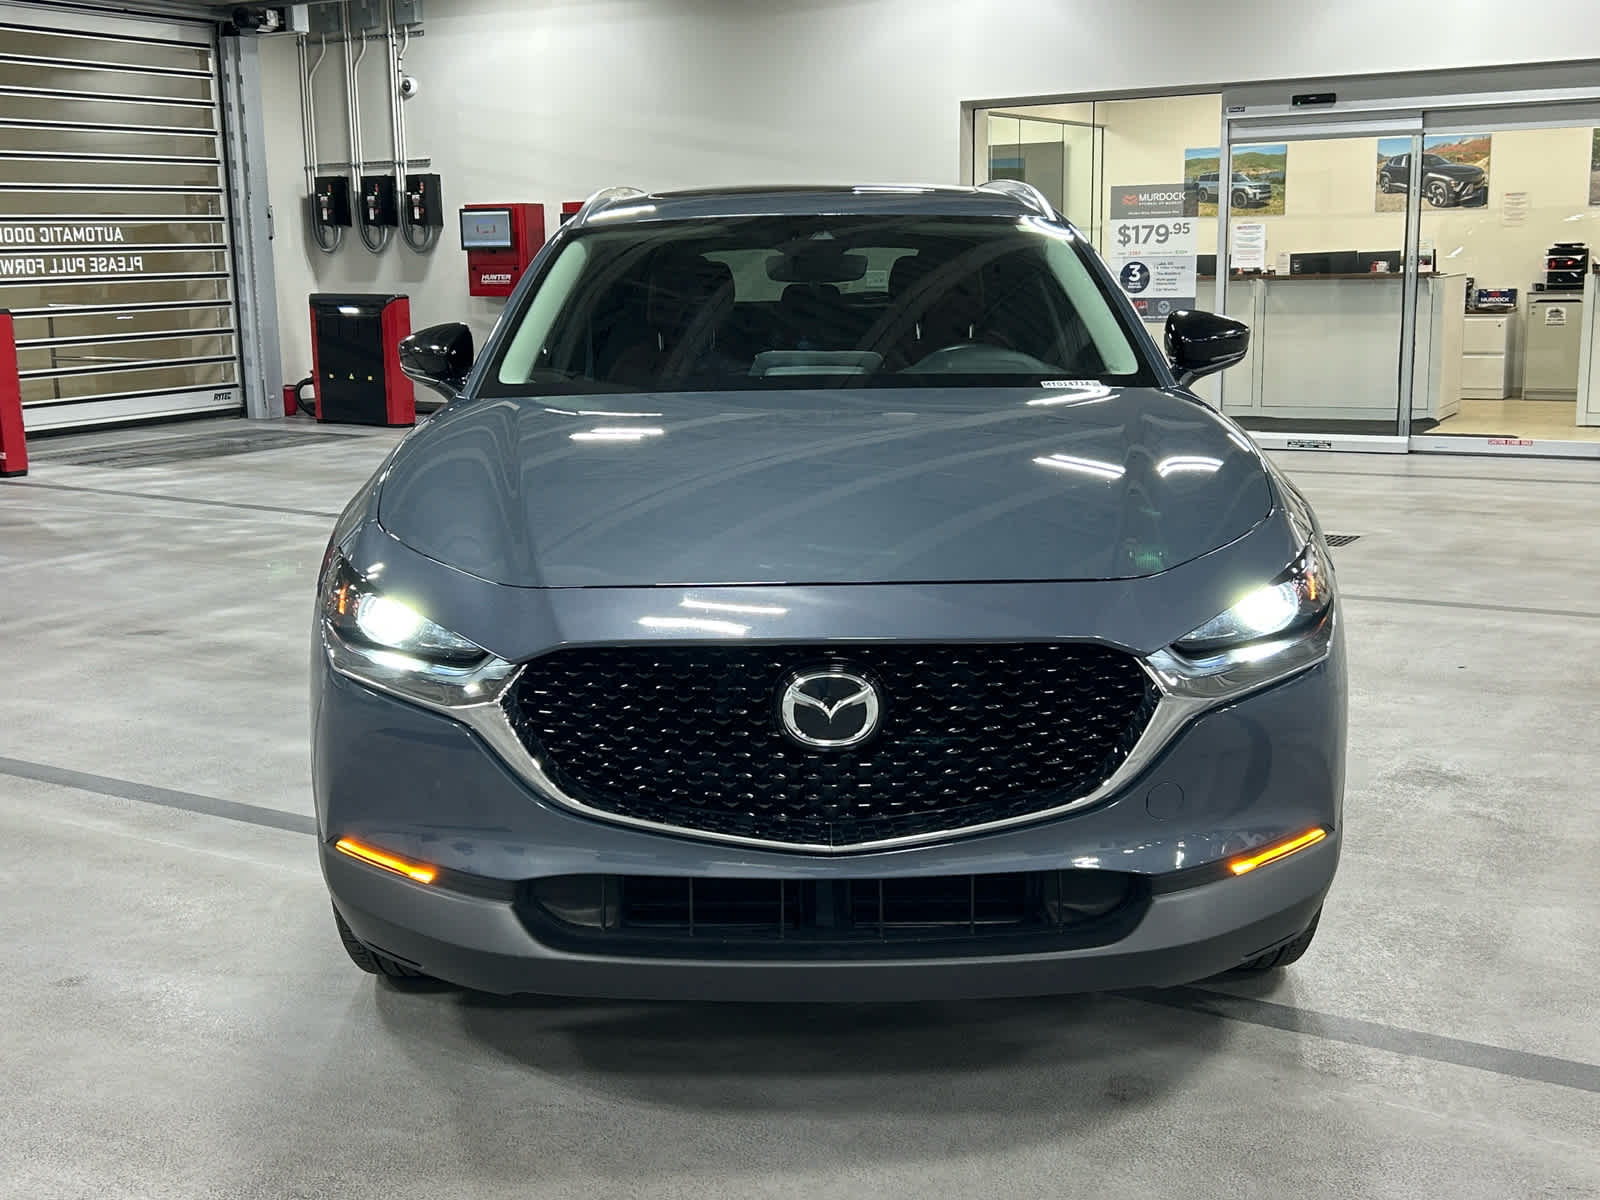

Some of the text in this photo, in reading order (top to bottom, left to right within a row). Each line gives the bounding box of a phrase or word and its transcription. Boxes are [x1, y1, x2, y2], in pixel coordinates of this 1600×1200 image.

[1138, 192, 1186, 201] MURDOCK
[1117, 222, 1191, 247] $179.95
[1128, 264, 1141, 282] 3
